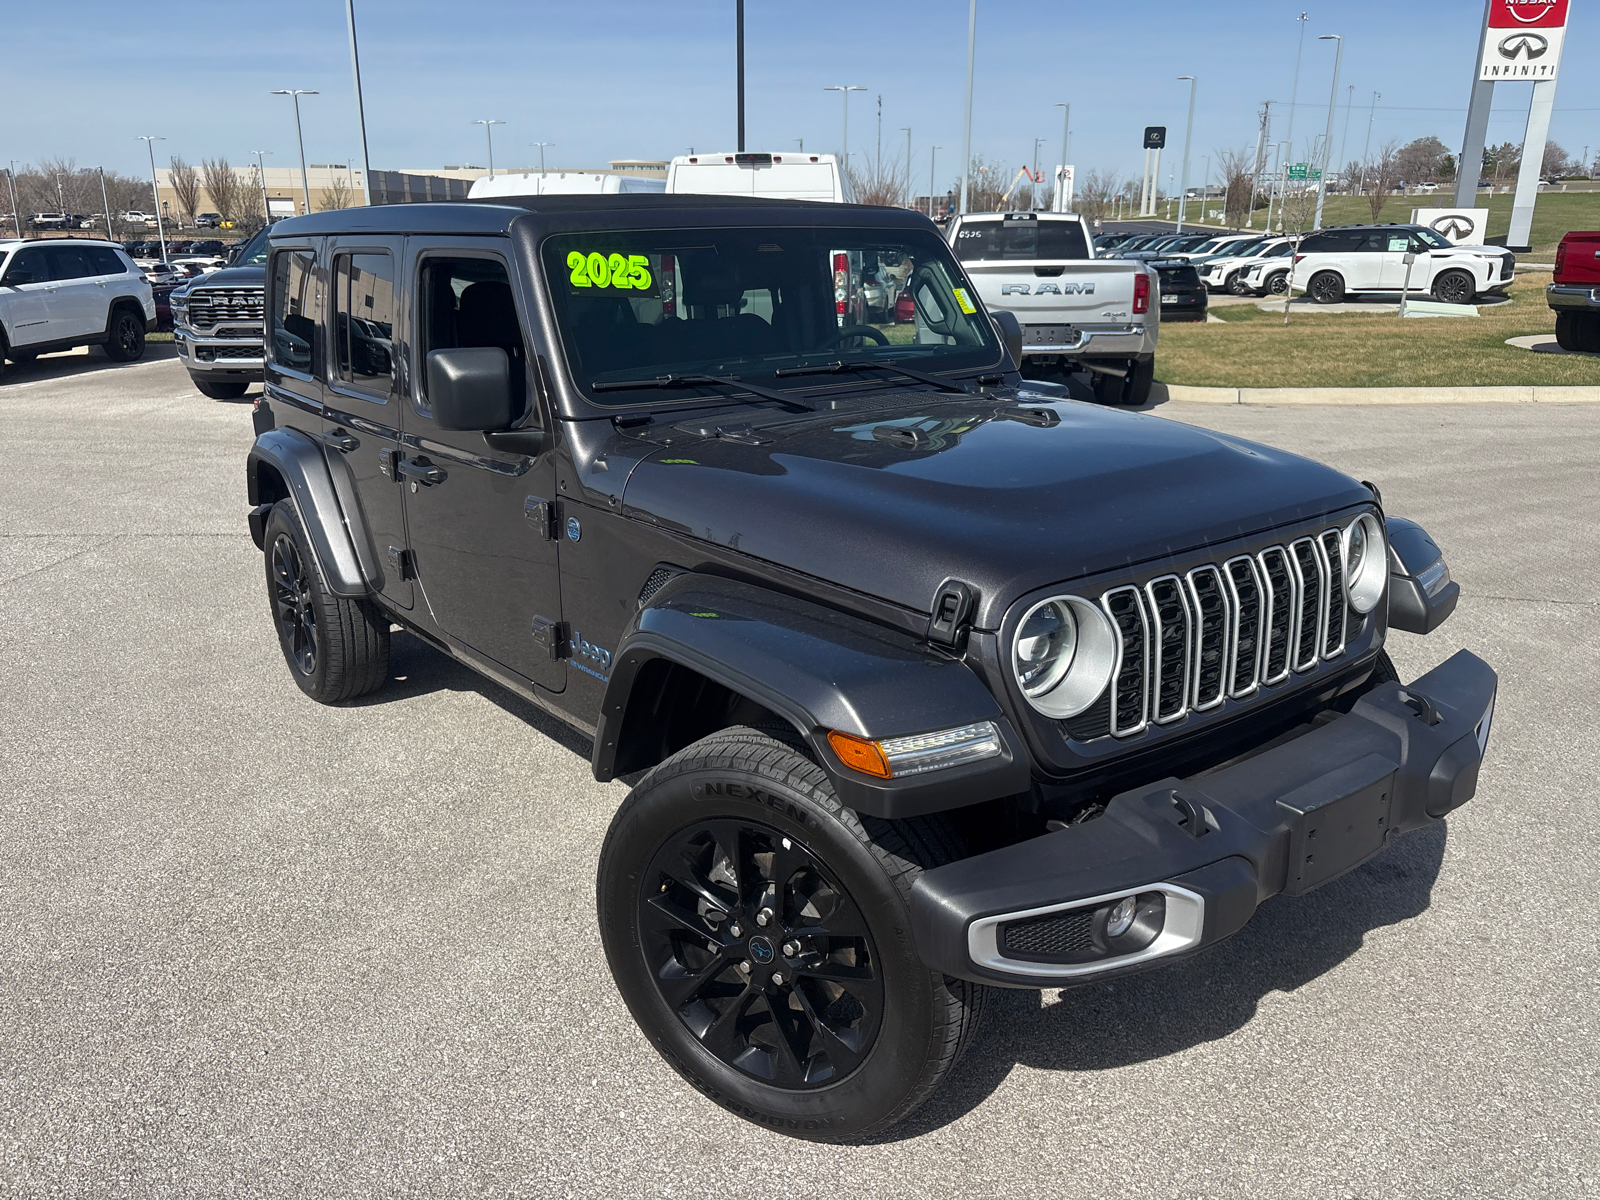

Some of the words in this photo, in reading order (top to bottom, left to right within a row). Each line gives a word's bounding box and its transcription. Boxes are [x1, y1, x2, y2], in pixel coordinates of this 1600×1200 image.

[1484, 65, 1555, 76] INFINITI
[566, 250, 652, 290] 2025
[1001, 282, 1095, 296] RAM
[212, 296, 264, 305] RAM
[569, 630, 611, 671] Jeep
[576, 662, 609, 683] WRANGLE
[704, 782, 809, 825] NEXEN
